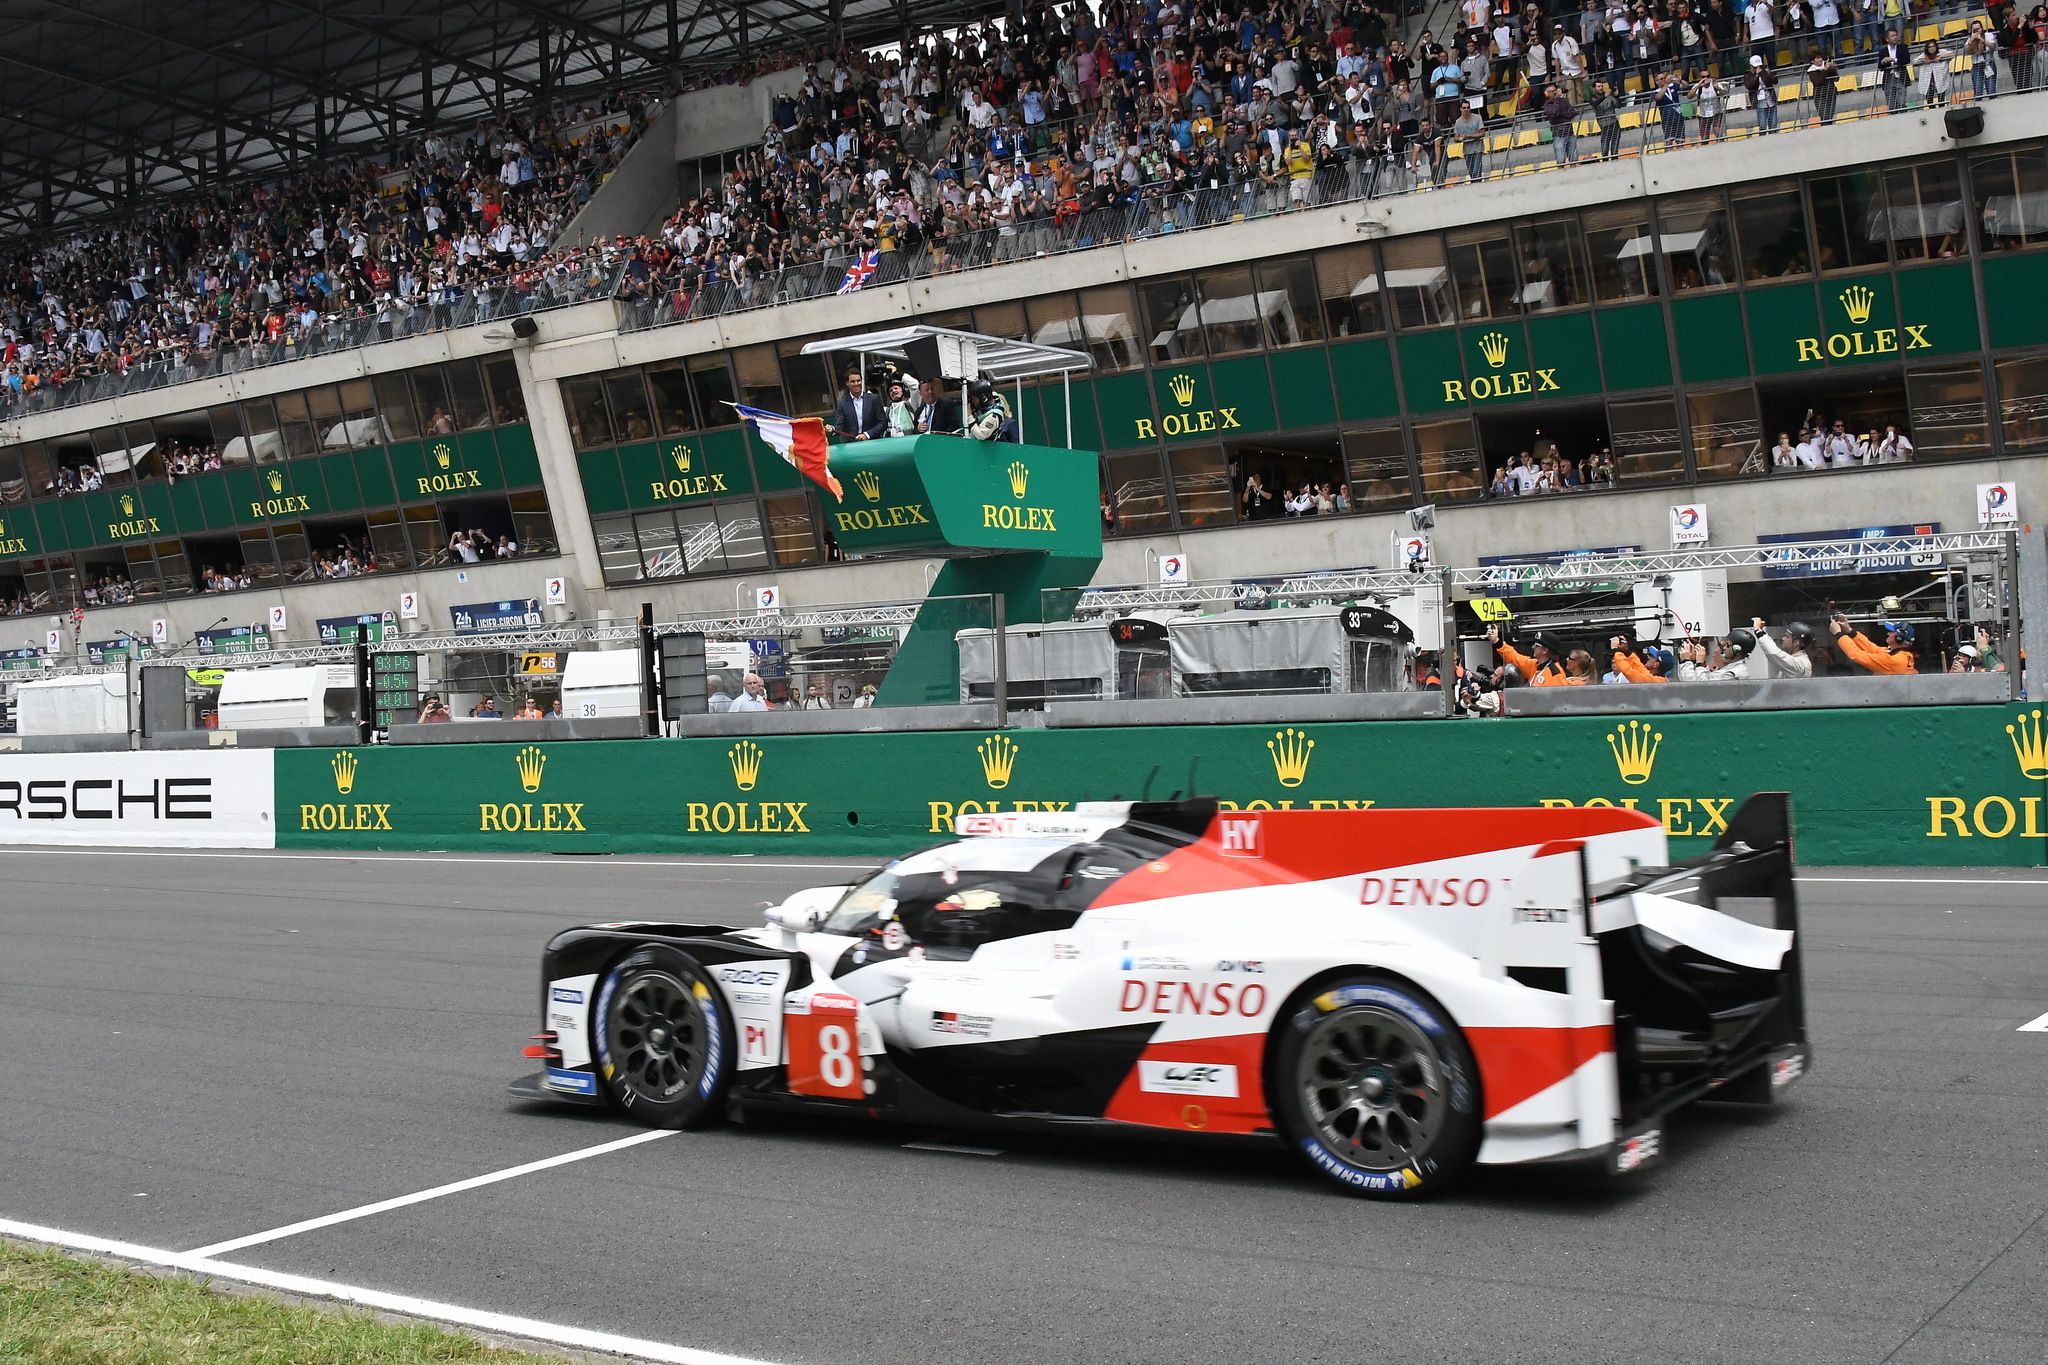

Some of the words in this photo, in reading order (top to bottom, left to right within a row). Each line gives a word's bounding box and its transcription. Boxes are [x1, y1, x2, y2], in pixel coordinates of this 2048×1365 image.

[1796, 324, 1932, 362] ROLEX
[1443, 368, 1560, 402] ROLEX
[1135, 407, 1241, 439] ROLEX
[417, 470, 482, 494] ROLEX
[651, 473, 727, 500] ROLEX
[251, 495, 310, 518] ROLEX
[835, 504, 929, 532] ROLEX
[982, 505, 1057, 532] ROLEX
[1981, 511, 2014, 519] TOTAL
[109, 517, 160, 538] ROLEX
[1675, 532, 1704, 540] TOTAL
[0, 538, 27, 554] LEX
[499, 602, 511, 611] LMP2
[1482, 601, 1496, 621] 94
[1120, 624, 1133, 640] 34
[1348, 611, 1361, 629] 33
[1685, 621, 1701, 634] 94
[350, 629, 374, 643] FOD
[756, 640, 768, 656] 91
[377, 655, 391, 671] 93
[395, 655, 410, 670] P6
[541, 657, 556, 669] 56
[583, 703, 597, 717] 38
[0, 778, 212, 819] RSCHE
[300, 803, 392, 831] ROLEX
[479, 803, 587, 832] ROLEX
[686, 802, 811, 833] ROLEX
[965, 817, 1018, 834] ZENT
[1925, 795, 2048, 838] ROL
[1220, 820, 1260, 851] HY
[1359, 877, 1491, 907] DENSO
[1119, 979, 1269, 1018] DENSO
[819, 1024, 855, 1088] 8
[1306, 1142, 1387, 1189] MICHELIN
